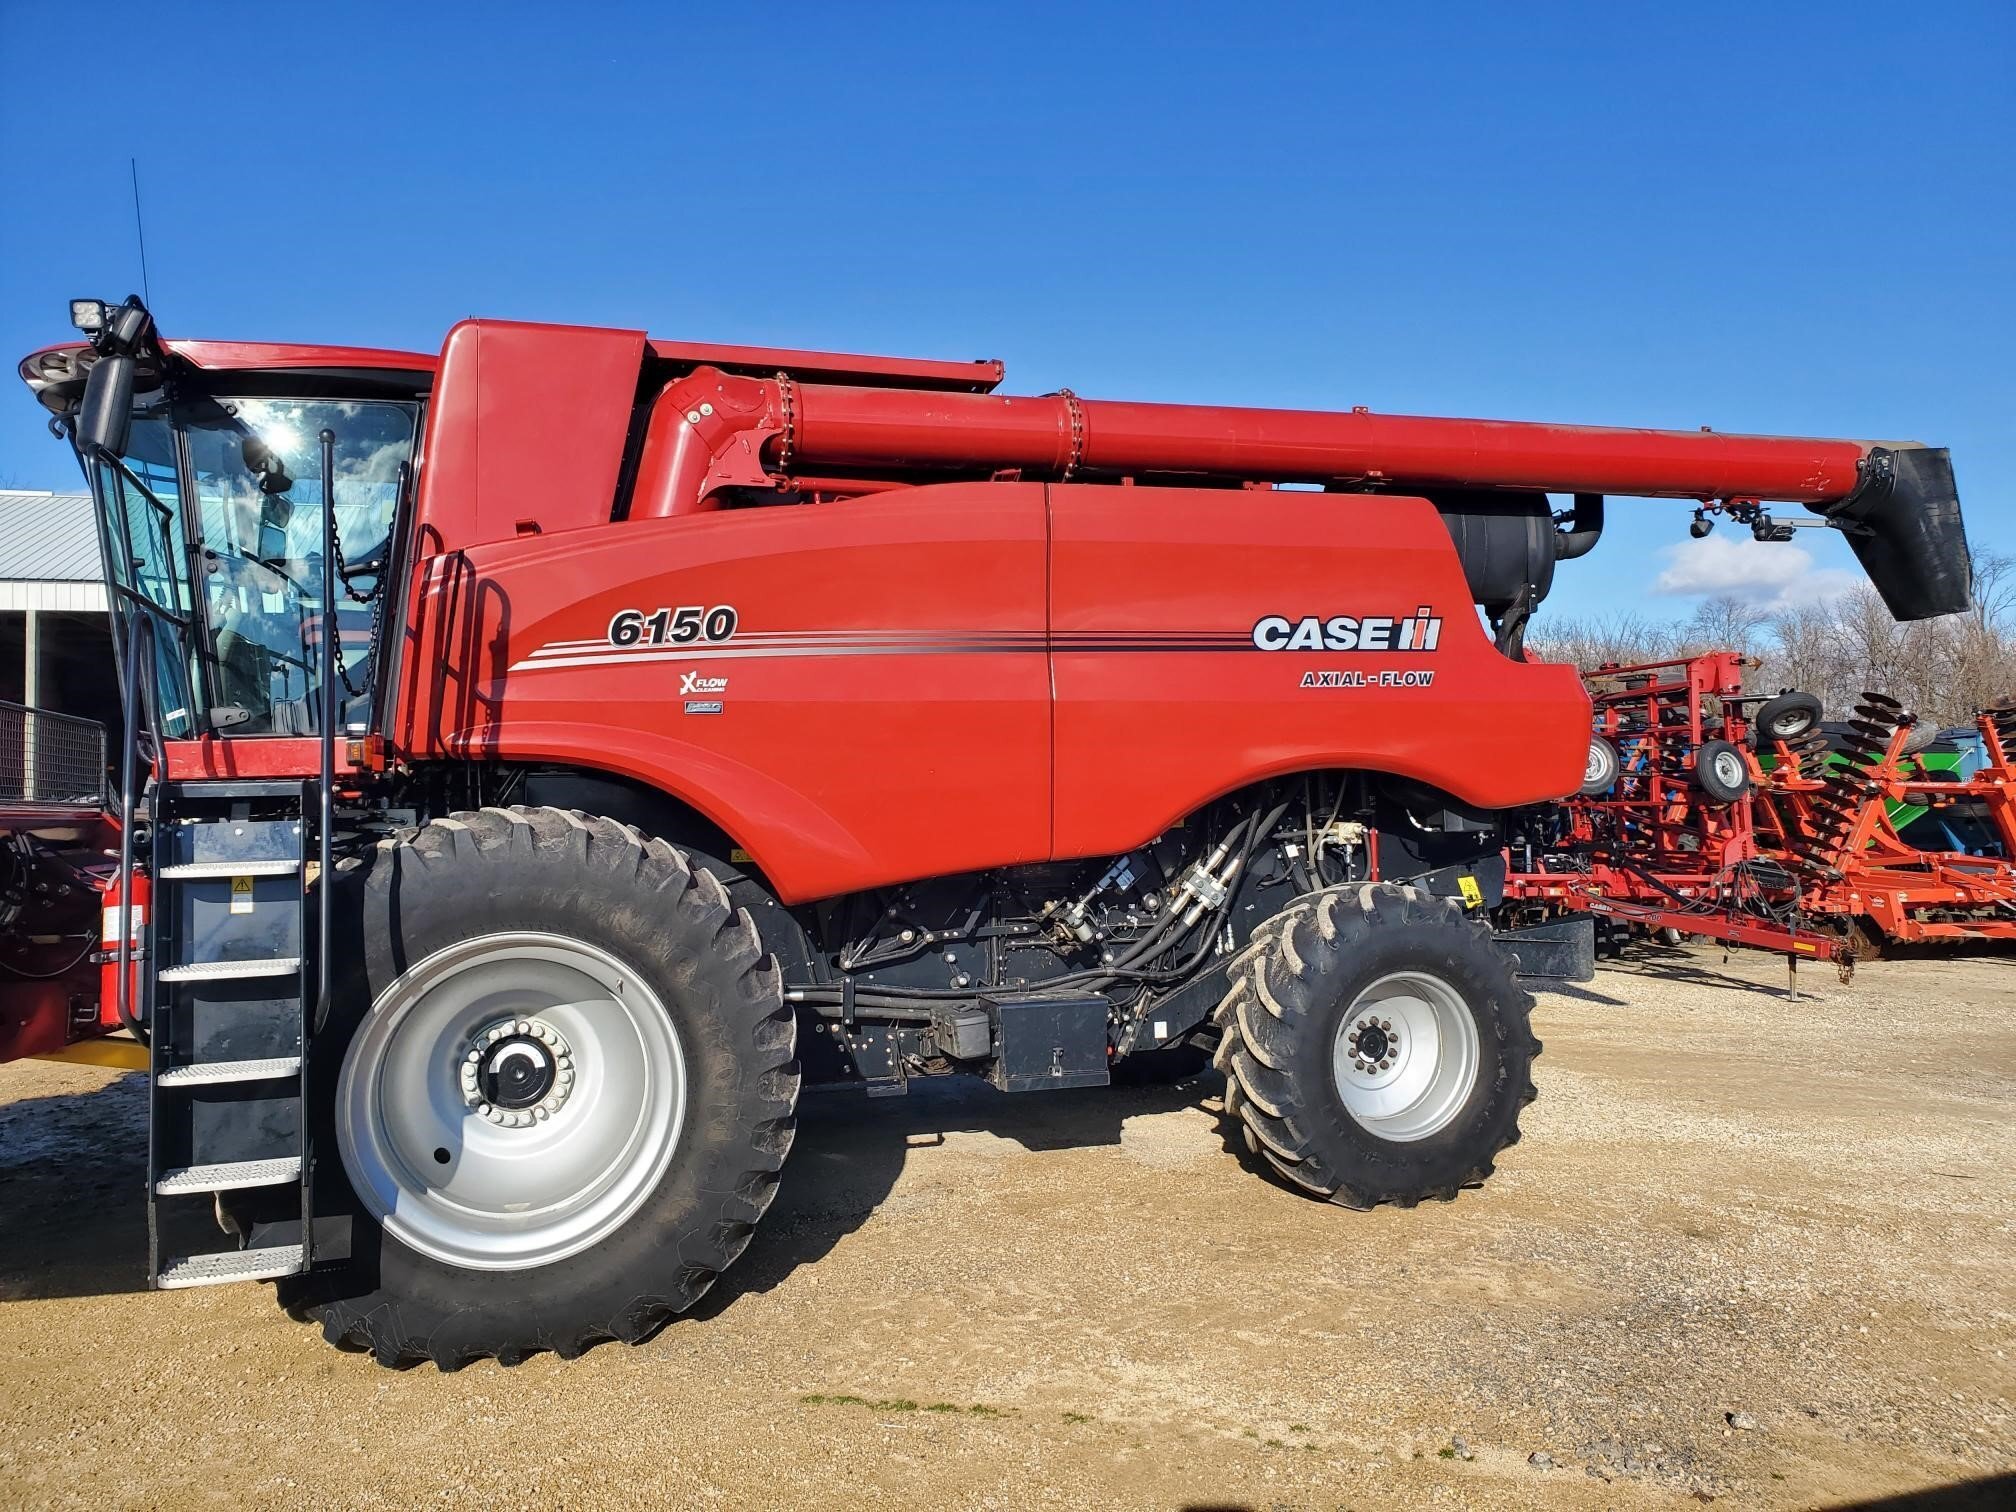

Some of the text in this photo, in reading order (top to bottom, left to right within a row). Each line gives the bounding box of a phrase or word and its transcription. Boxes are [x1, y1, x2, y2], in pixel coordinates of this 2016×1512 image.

[608, 605, 738, 648] 6150
[1252, 616, 1395, 651] CASE
[1300, 671, 1435, 688] AXIAL-FLOW
